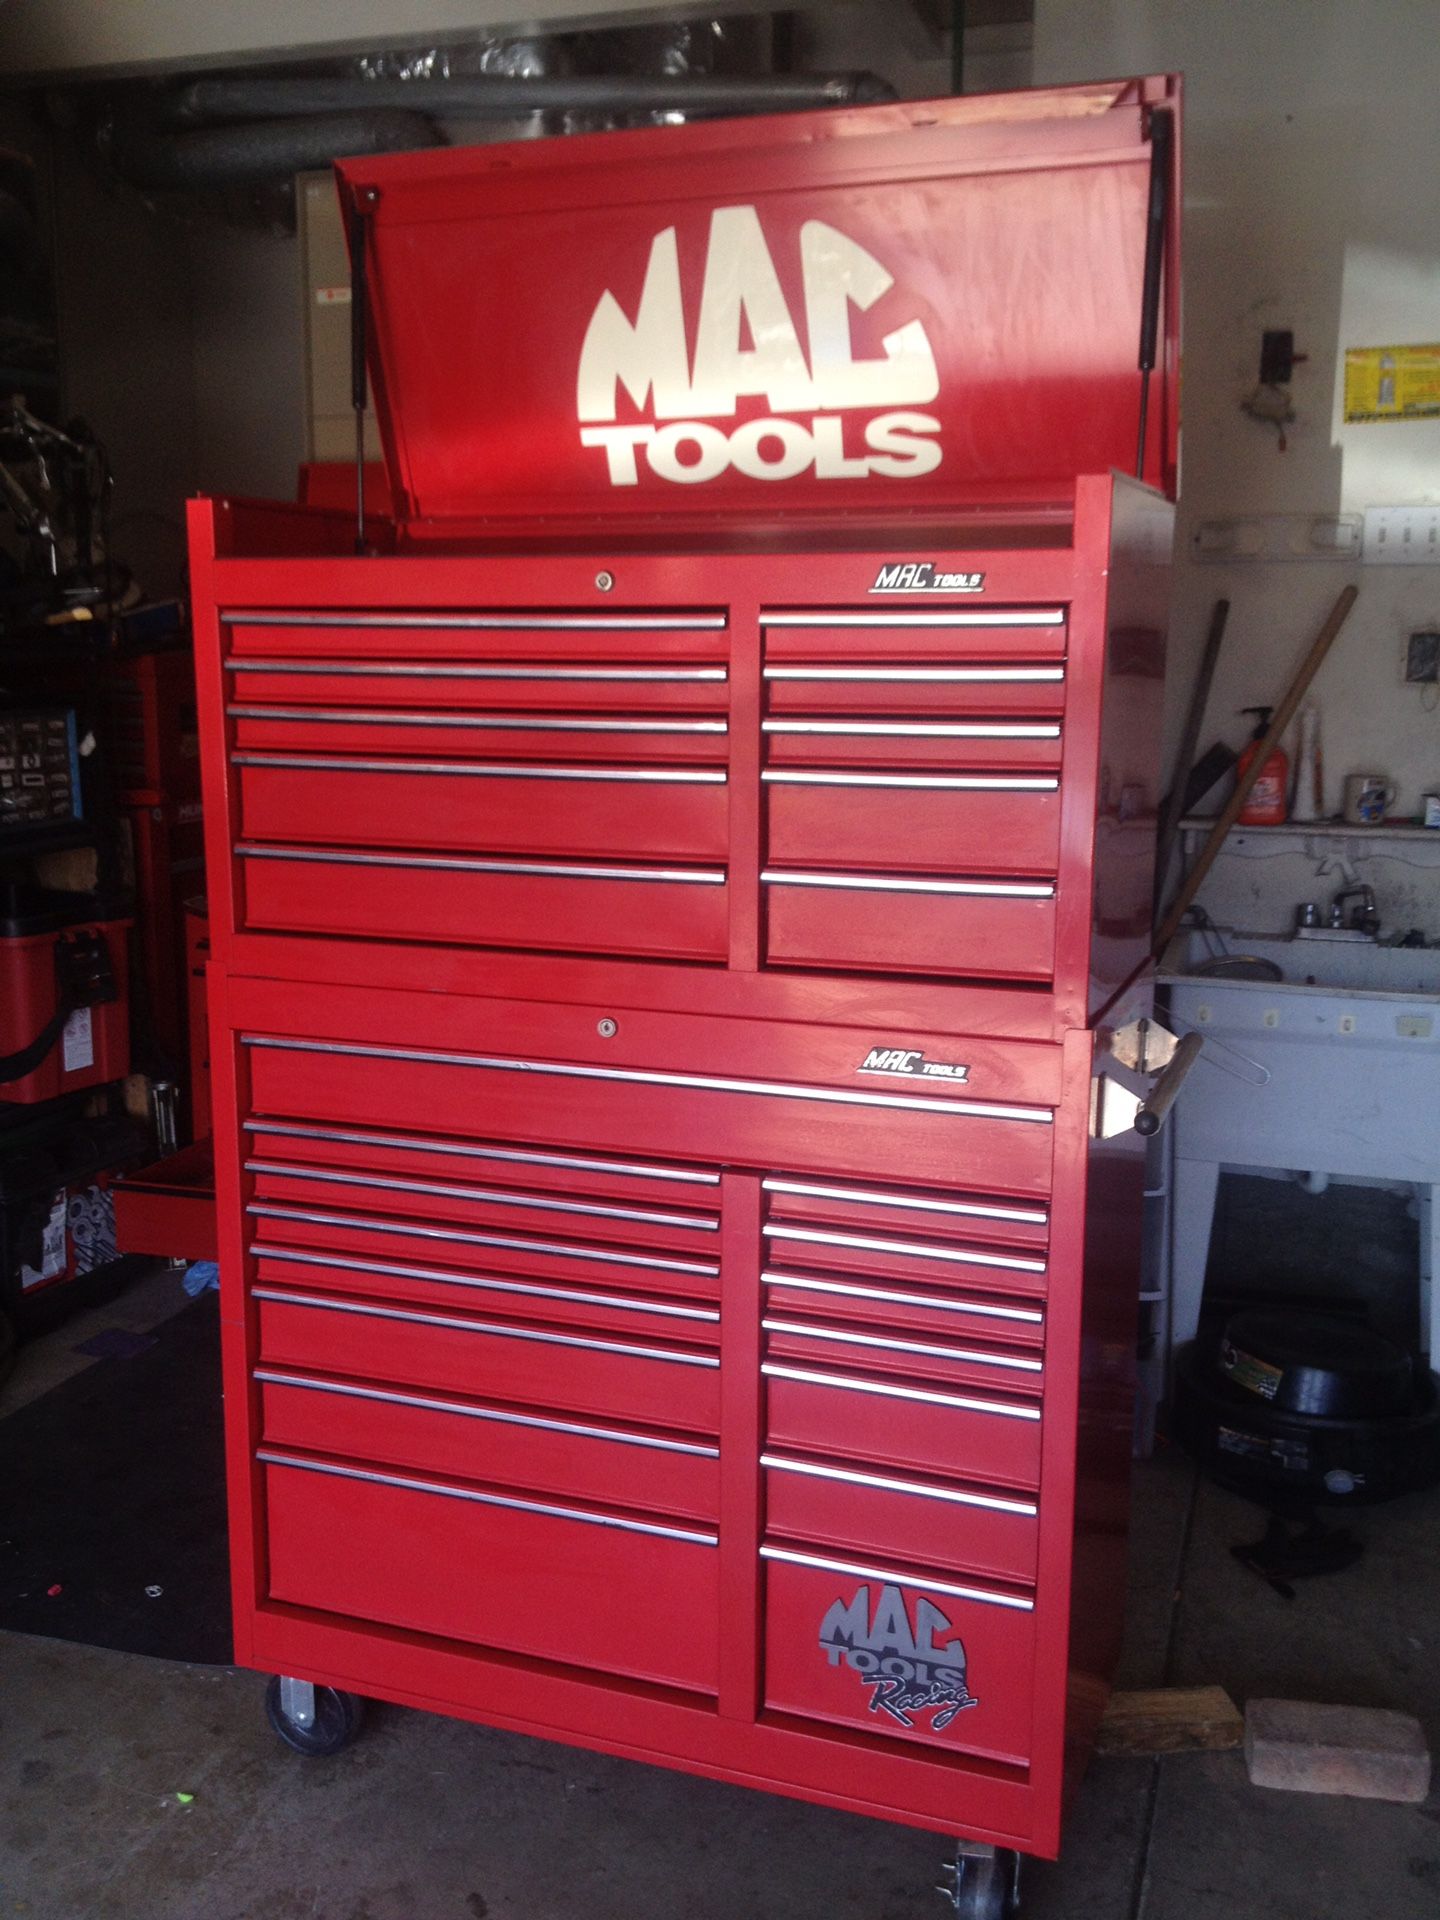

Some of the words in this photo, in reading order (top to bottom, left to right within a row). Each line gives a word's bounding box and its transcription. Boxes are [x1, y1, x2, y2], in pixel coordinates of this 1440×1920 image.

[576, 205, 940, 423] MAC
[579, 411, 943, 486] TOOLS
[875, 563, 932, 588] MAC
[933, 573, 982, 587] TOOLS
[863, 1050, 922, 1073] MAC
[922, 1063, 967, 1077] TOOLS
[819, 1584, 967, 1669] MAC
[819, 1641, 966, 1689] TOOLS
[862, 1674, 978, 1731] Racing
